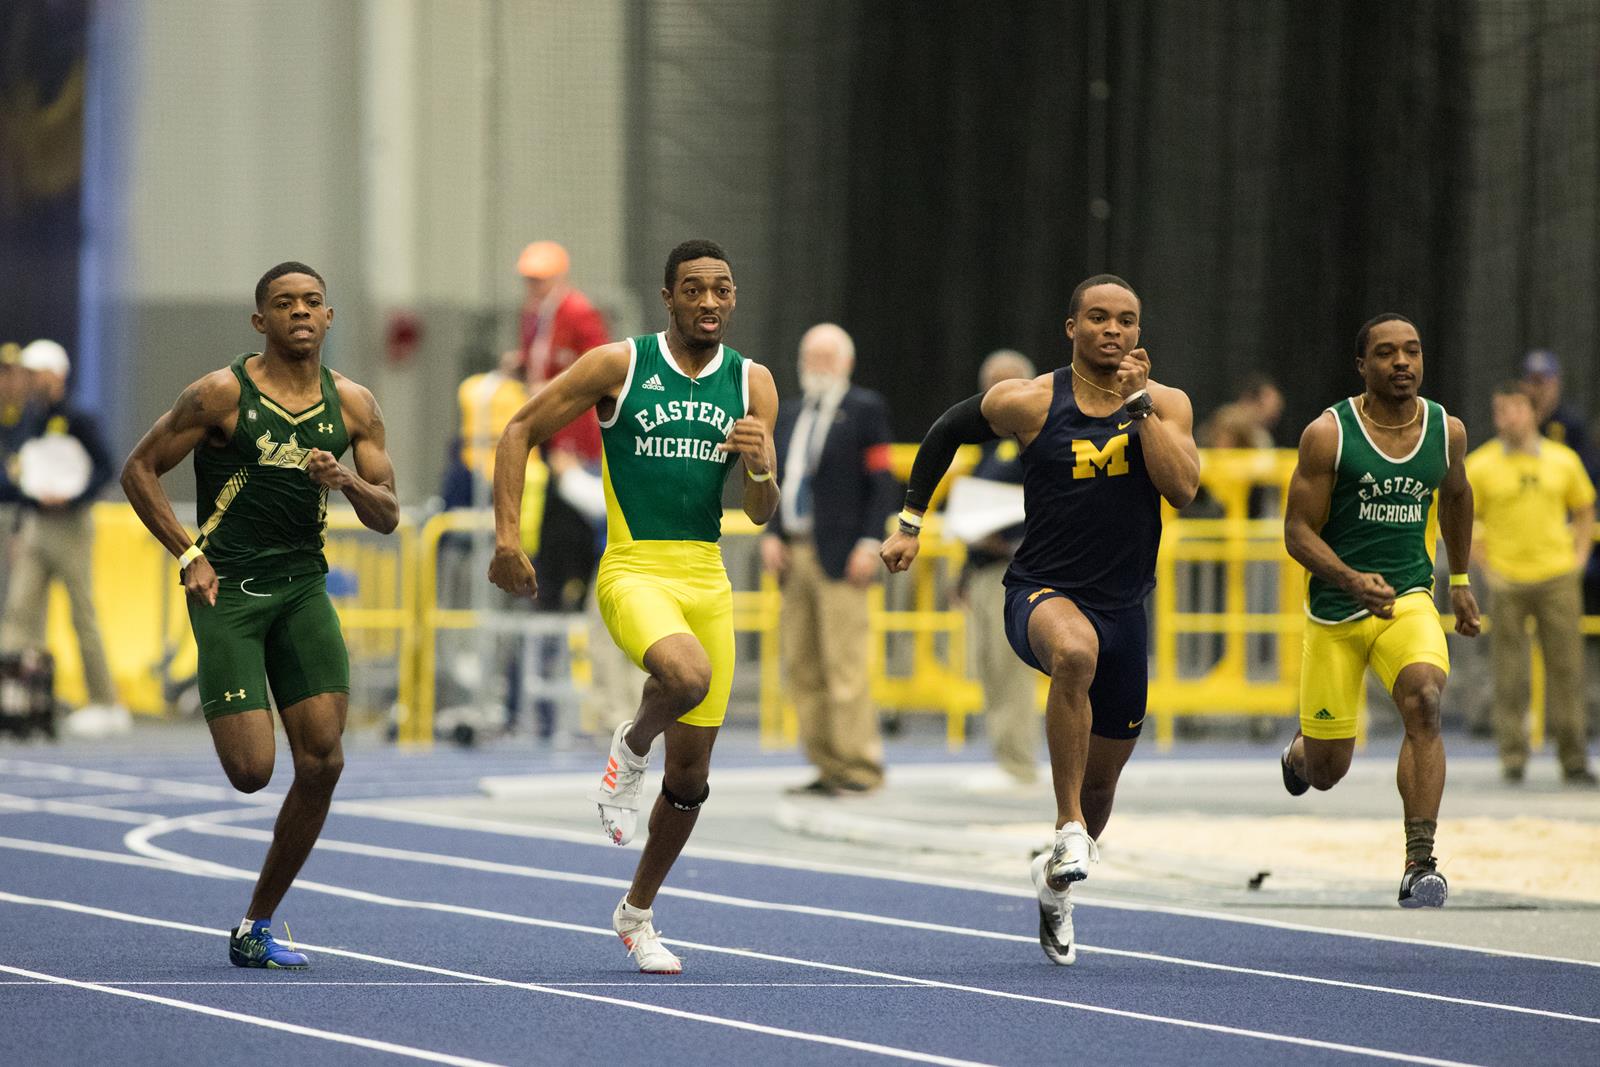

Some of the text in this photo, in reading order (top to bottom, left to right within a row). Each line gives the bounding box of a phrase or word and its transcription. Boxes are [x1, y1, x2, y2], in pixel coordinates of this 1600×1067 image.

[642, 383, 665, 392] adidas
[634, 401, 735, 440] EASTERN
[635, 436, 728, 464] MICHIGAN
[1071, 433, 1129, 480] M
[1358, 476, 1430, 502] EASTERN
[1358, 502, 1422, 523] MICHIGAN
